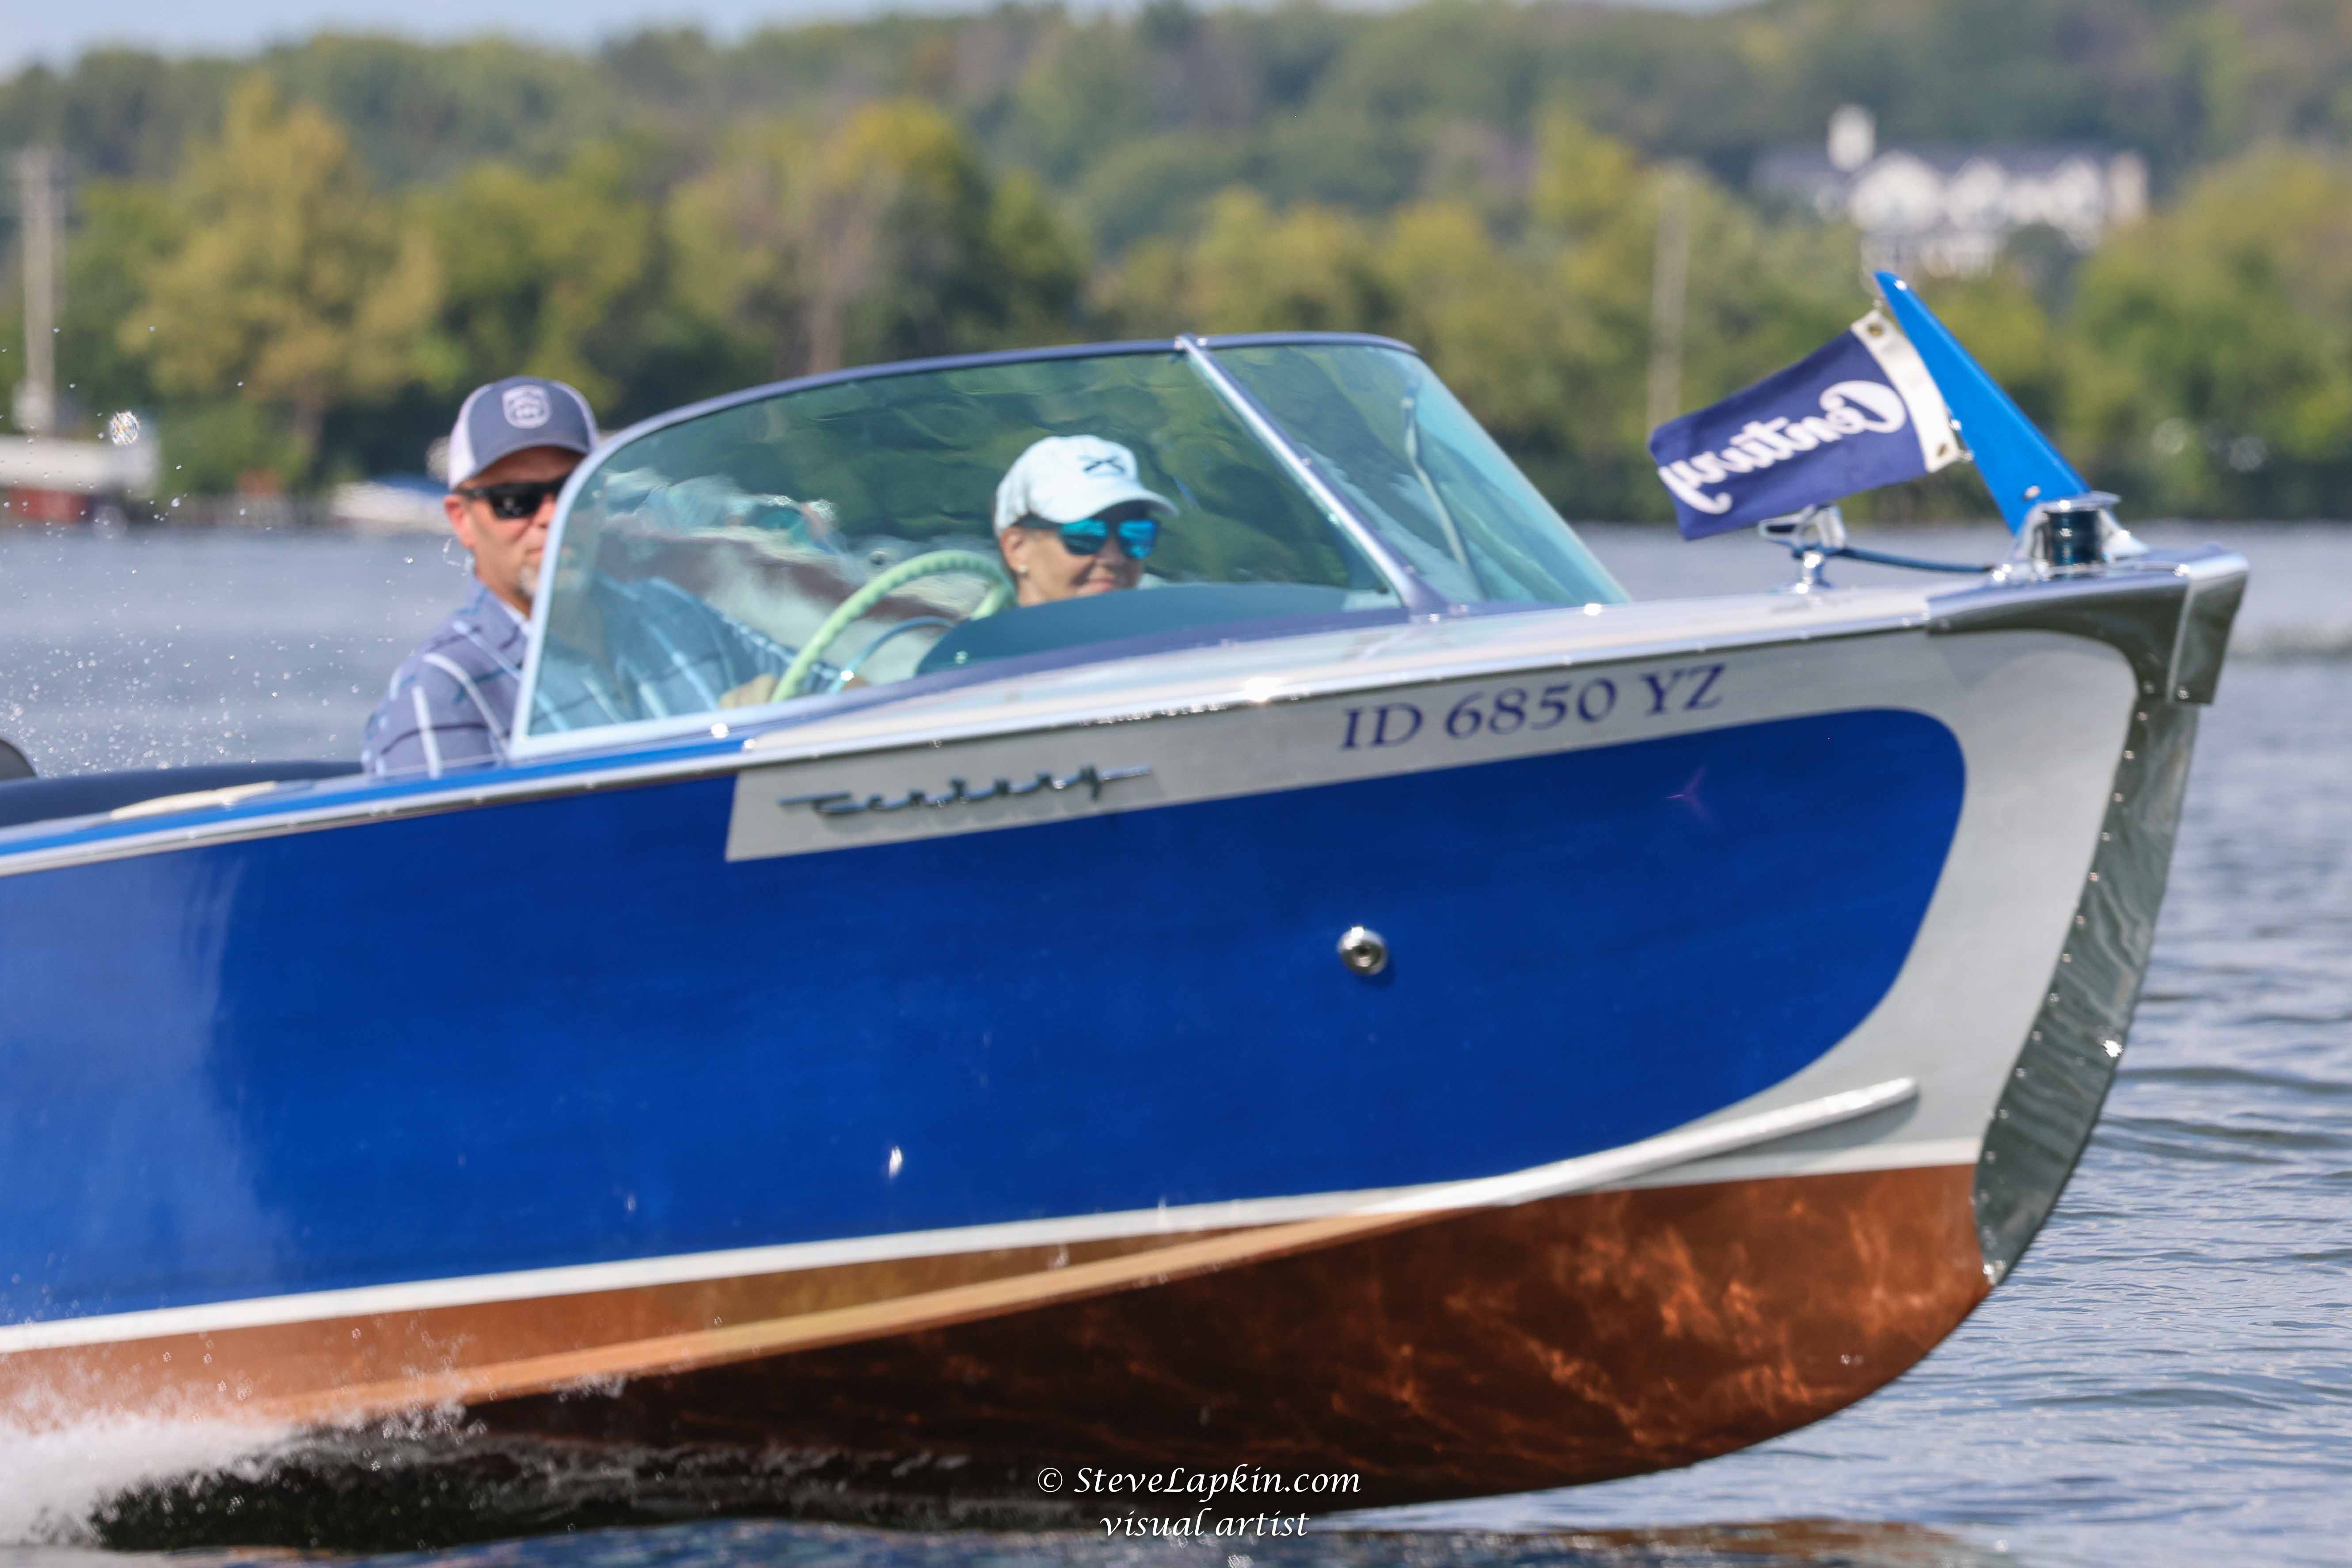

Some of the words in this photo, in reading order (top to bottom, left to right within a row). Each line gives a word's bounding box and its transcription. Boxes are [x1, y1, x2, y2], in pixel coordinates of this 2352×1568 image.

[1339, 703, 1423, 752] ID
[1444, 678, 1617, 740] 6850
[1640, 662, 1726, 715] YZ
